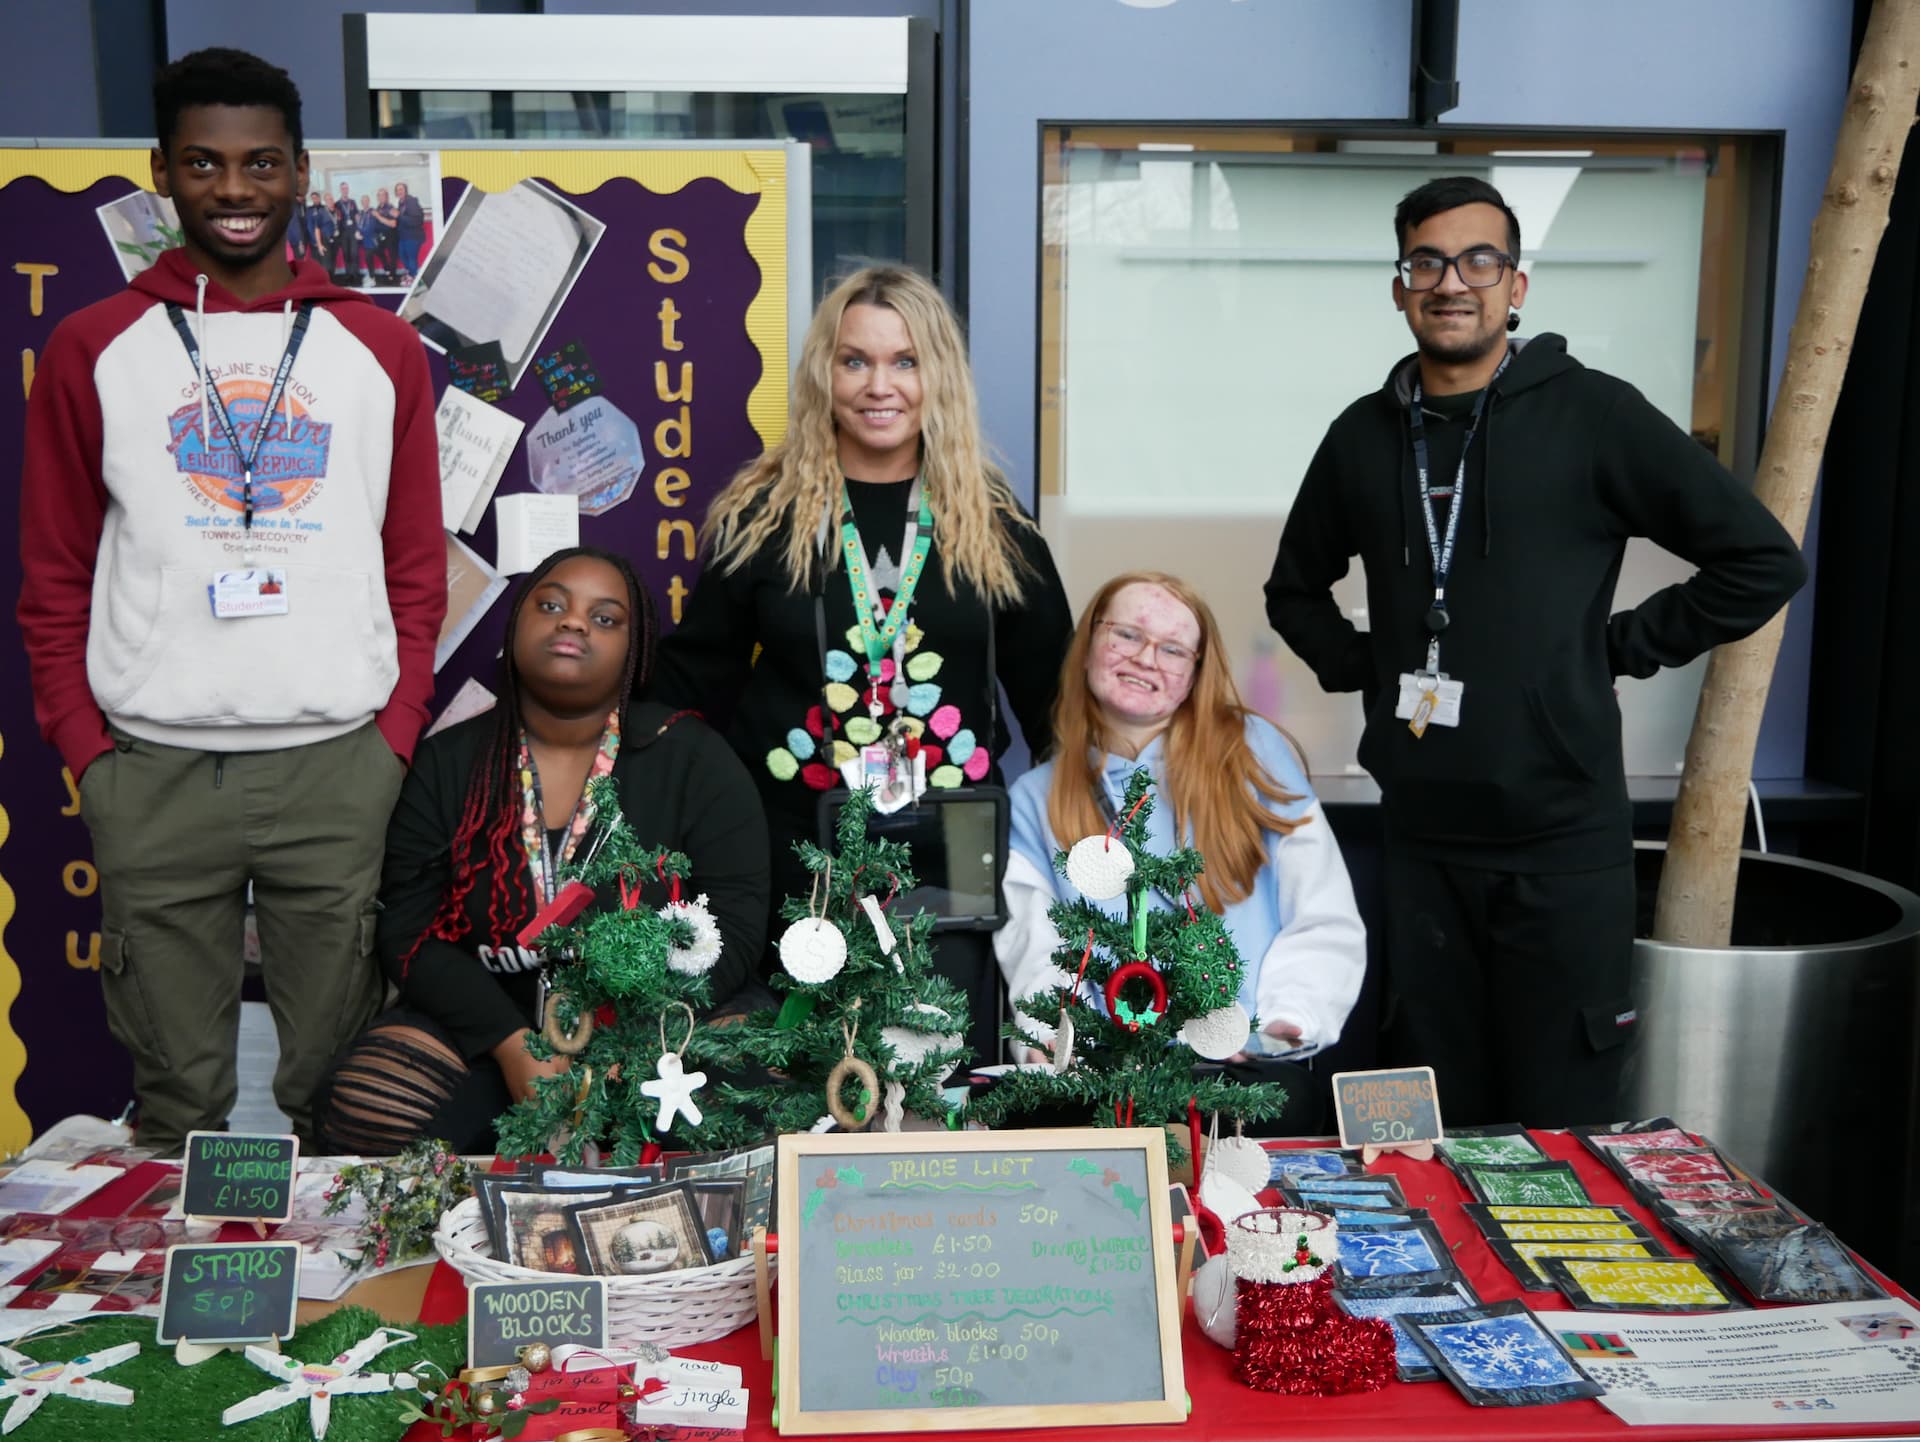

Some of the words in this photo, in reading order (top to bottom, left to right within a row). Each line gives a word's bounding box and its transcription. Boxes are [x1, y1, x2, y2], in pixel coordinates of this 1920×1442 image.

[181, 361, 255, 400] GAOLINE
[258, 364, 318, 406] STTION
[537, 418, 575, 448] Thank
[579, 407, 603, 433] you
[287, 480, 324, 516] BRAKES
[200, 530, 241, 540] TOWING
[1343, 1079, 1433, 1105] CHRISTMAS
[1355, 1100, 1413, 1122] CARDS
[1371, 1120, 1415, 1141] 50p
[201, 1140, 281, 1160] DRIVING
[213, 1160, 291, 1181] LICENCE
[888, 1158, 959, 1180] PRICE
[973, 1157, 1034, 1176] LIST
[834, 1210, 934, 1233] Christmas
[1018, 1203, 1059, 1226] 50p
[1529, 1227, 1624, 1240] MERRY
[182, 1248, 288, 1284] STARS
[836, 1264, 884, 1285] Glass
[1594, 1265, 1691, 1281] MERRY
[191, 1288, 256, 1326] 50p
[484, 1286, 592, 1315] WOODEN
[497, 1312, 593, 1340] BLOCKS
[878, 1323, 938, 1343] Wooden
[945, 1321, 999, 1342] blocks
[1020, 1322, 1061, 1344] 50p
[1623, 1327, 1669, 1336] WINTER
[1718, 1319, 1807, 1333] INDEPENDENCE
[1660, 1334, 1717, 1343] PRINTING
[1718, 1327, 1788, 1341] CHRISTMAS
[1789, 1324, 1830, 1334] CARDS
[680, 1360, 723, 1375] noel
[875, 1364, 918, 1392] Clay
[934, 1365, 975, 1388] 50p
[559, 1401, 613, 1416] noel
[673, 1387, 741, 1413] jingle
